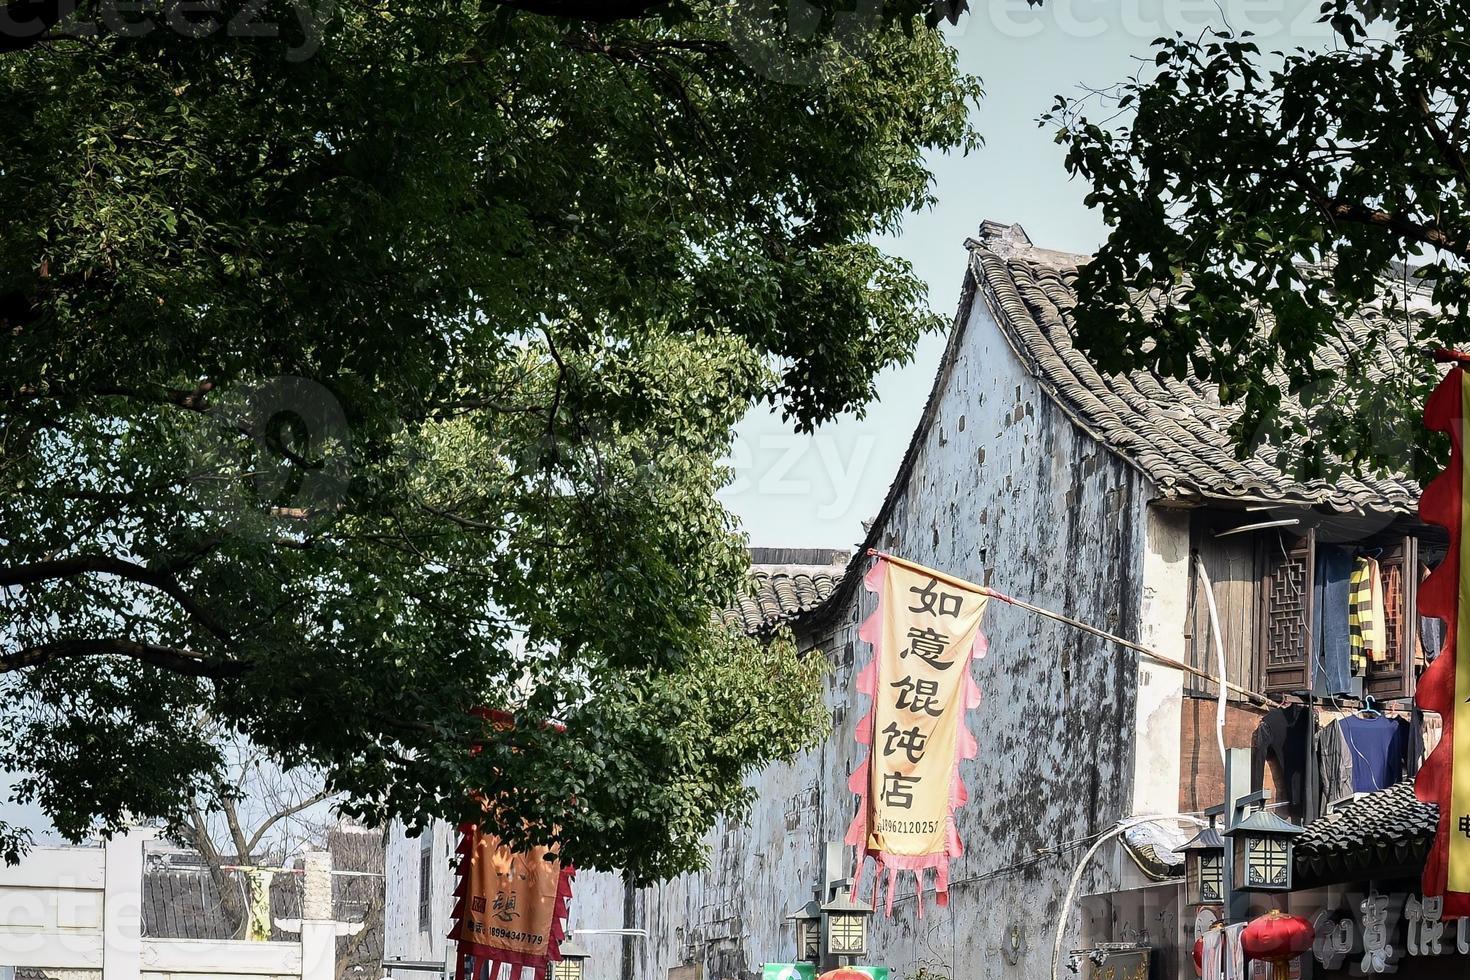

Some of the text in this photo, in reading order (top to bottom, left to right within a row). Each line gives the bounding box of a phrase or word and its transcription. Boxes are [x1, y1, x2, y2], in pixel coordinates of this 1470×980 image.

[880, 578, 964, 810] 如意馄饨店
